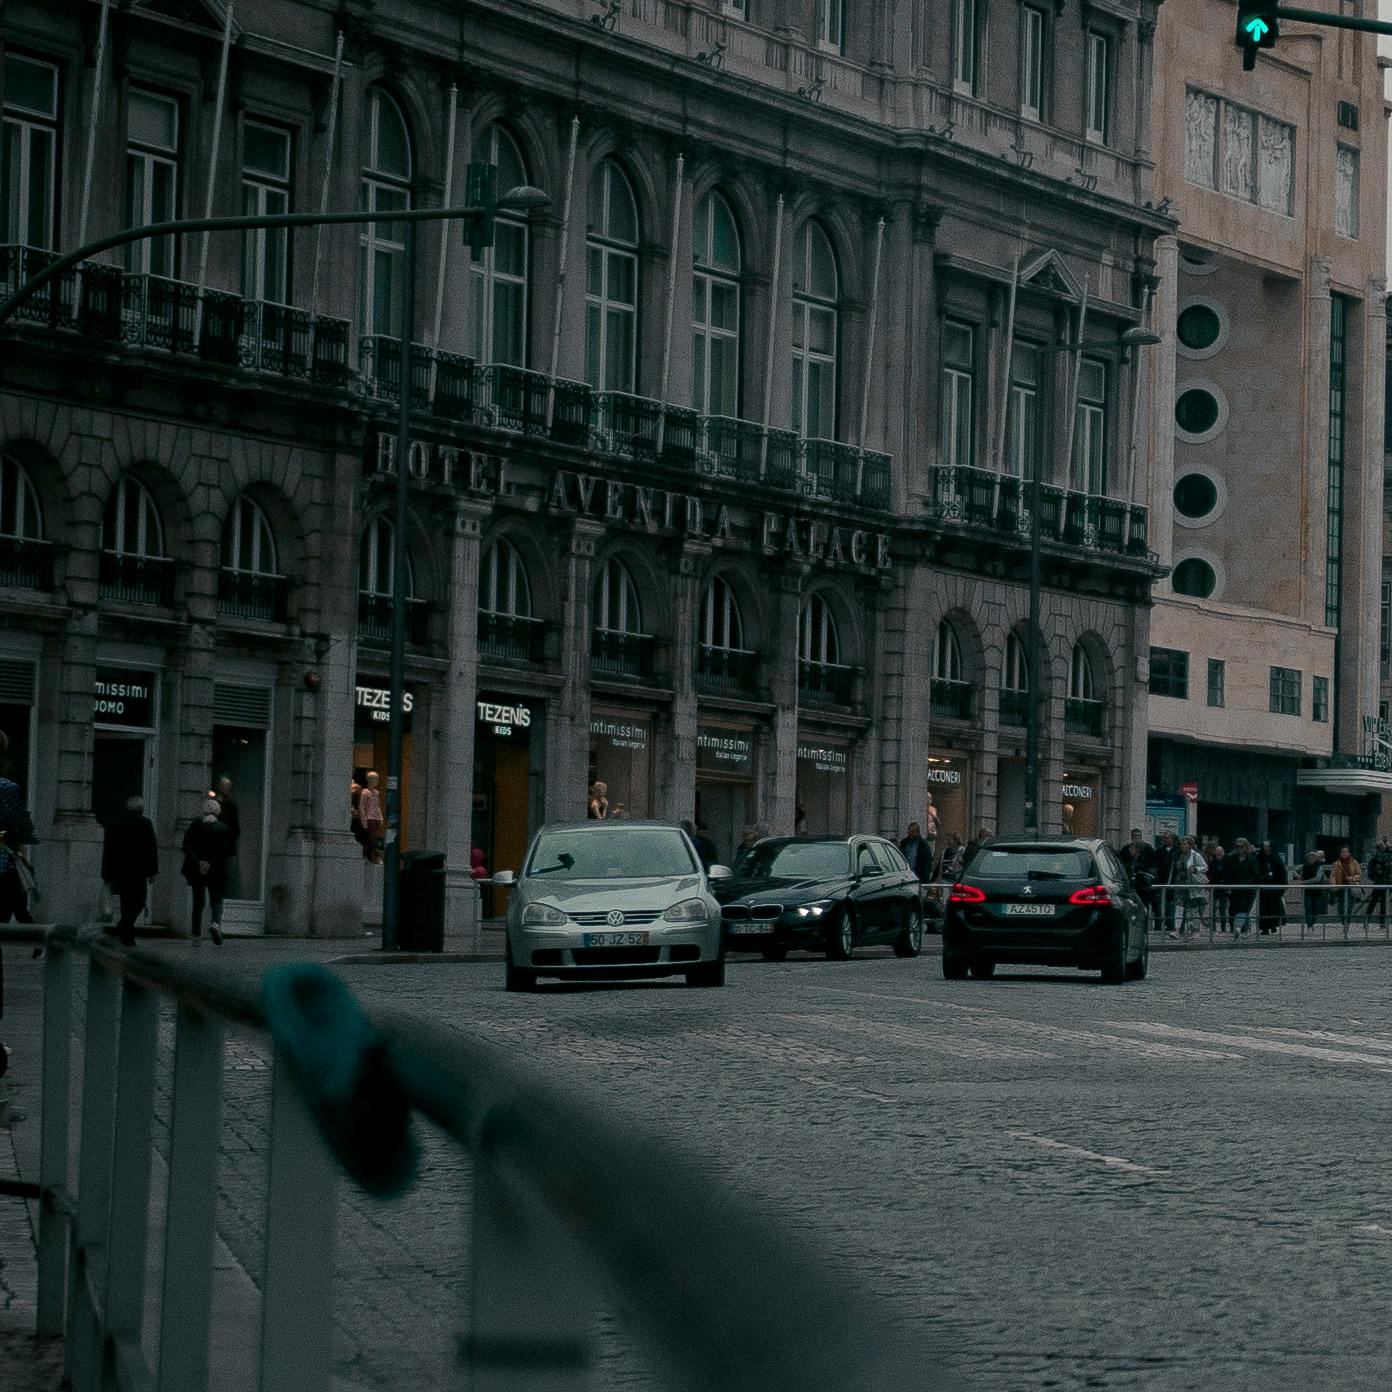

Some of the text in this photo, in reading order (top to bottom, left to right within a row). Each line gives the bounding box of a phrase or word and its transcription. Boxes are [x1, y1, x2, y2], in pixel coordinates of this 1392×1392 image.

[376, 431, 893, 570] HOTEL AVENIDA PALACE
[95, 681, 148, 699] missimi
[355, 686, 414, 713] TEZES
[696, 734, 749, 753] ntimissimi
[797, 746, 847, 764] ntimissimi
[927, 768, 961, 784] ALCONERI
